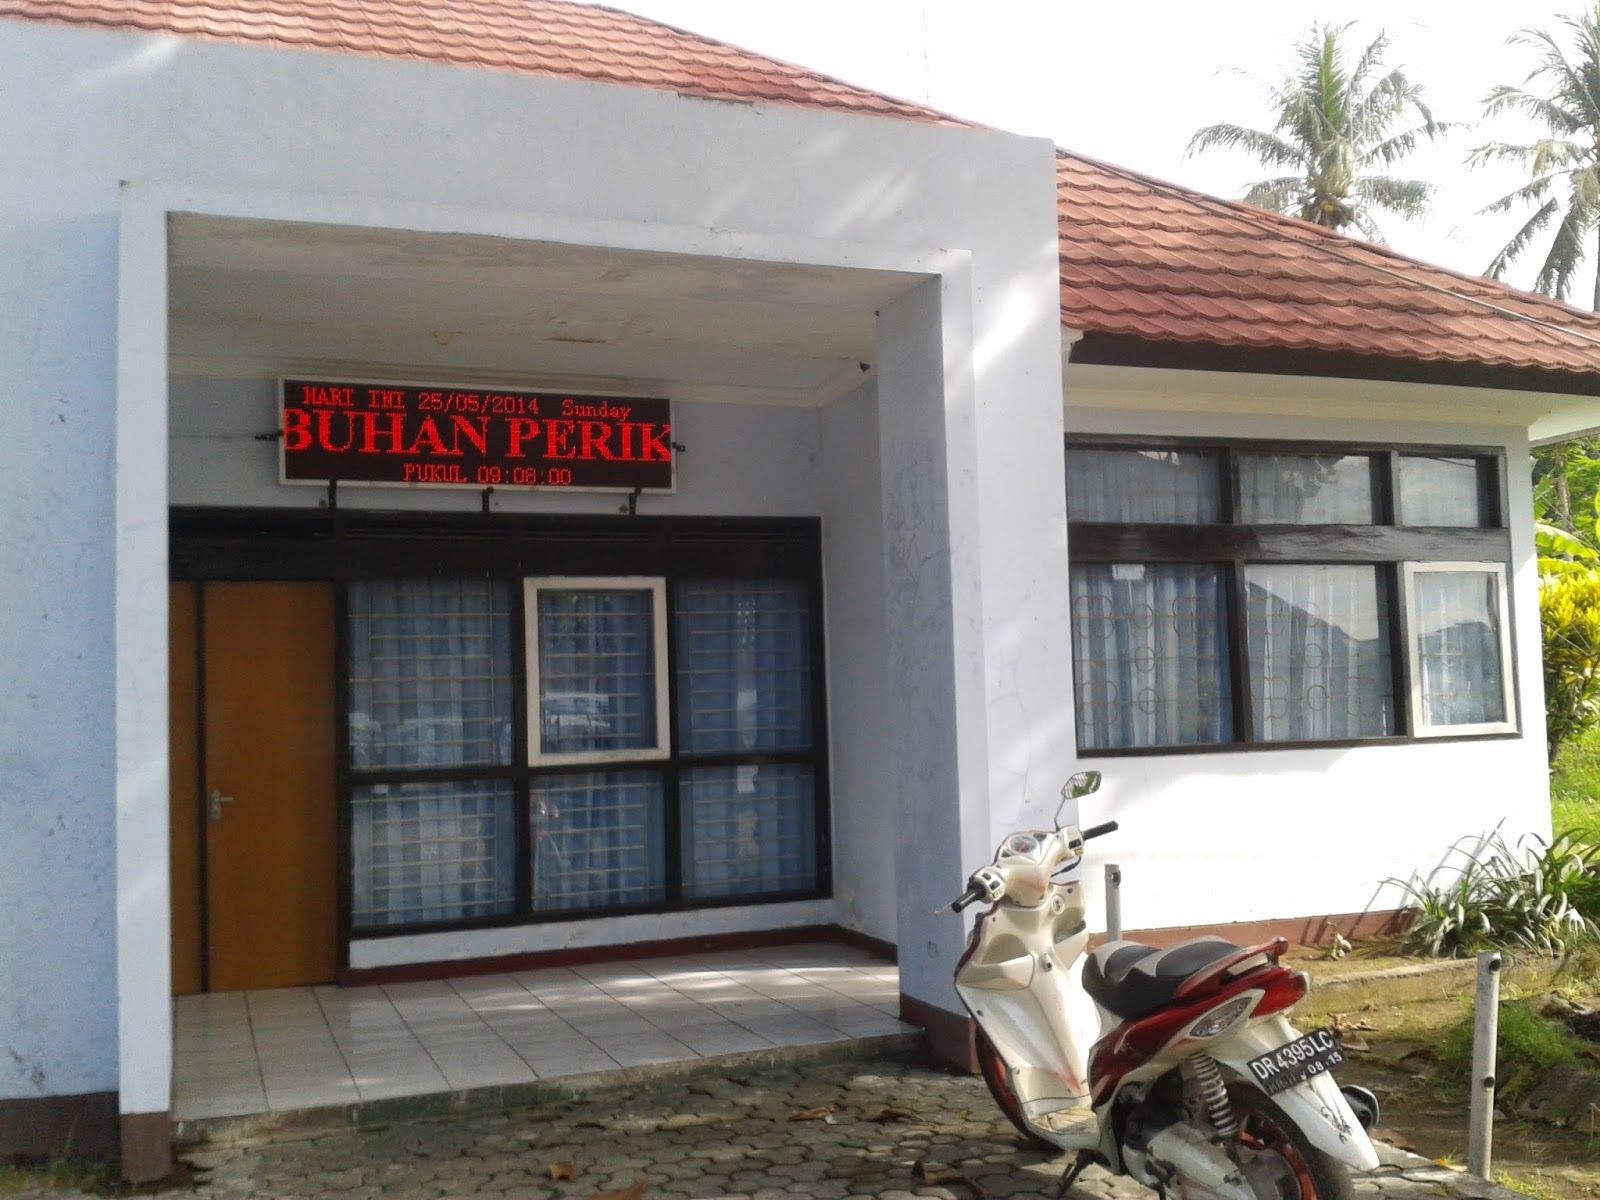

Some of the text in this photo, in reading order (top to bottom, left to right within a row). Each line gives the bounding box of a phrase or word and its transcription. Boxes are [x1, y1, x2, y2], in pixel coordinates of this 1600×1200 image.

[303, 387, 354, 407] HARI
[417, 392, 540, 416] 25/05/2014
[562, 399, 631, 421] Sunday
[283, 409, 671, 462] BUHAN PERIK
[403, 464, 571, 485] PUKUL 09:08:00
